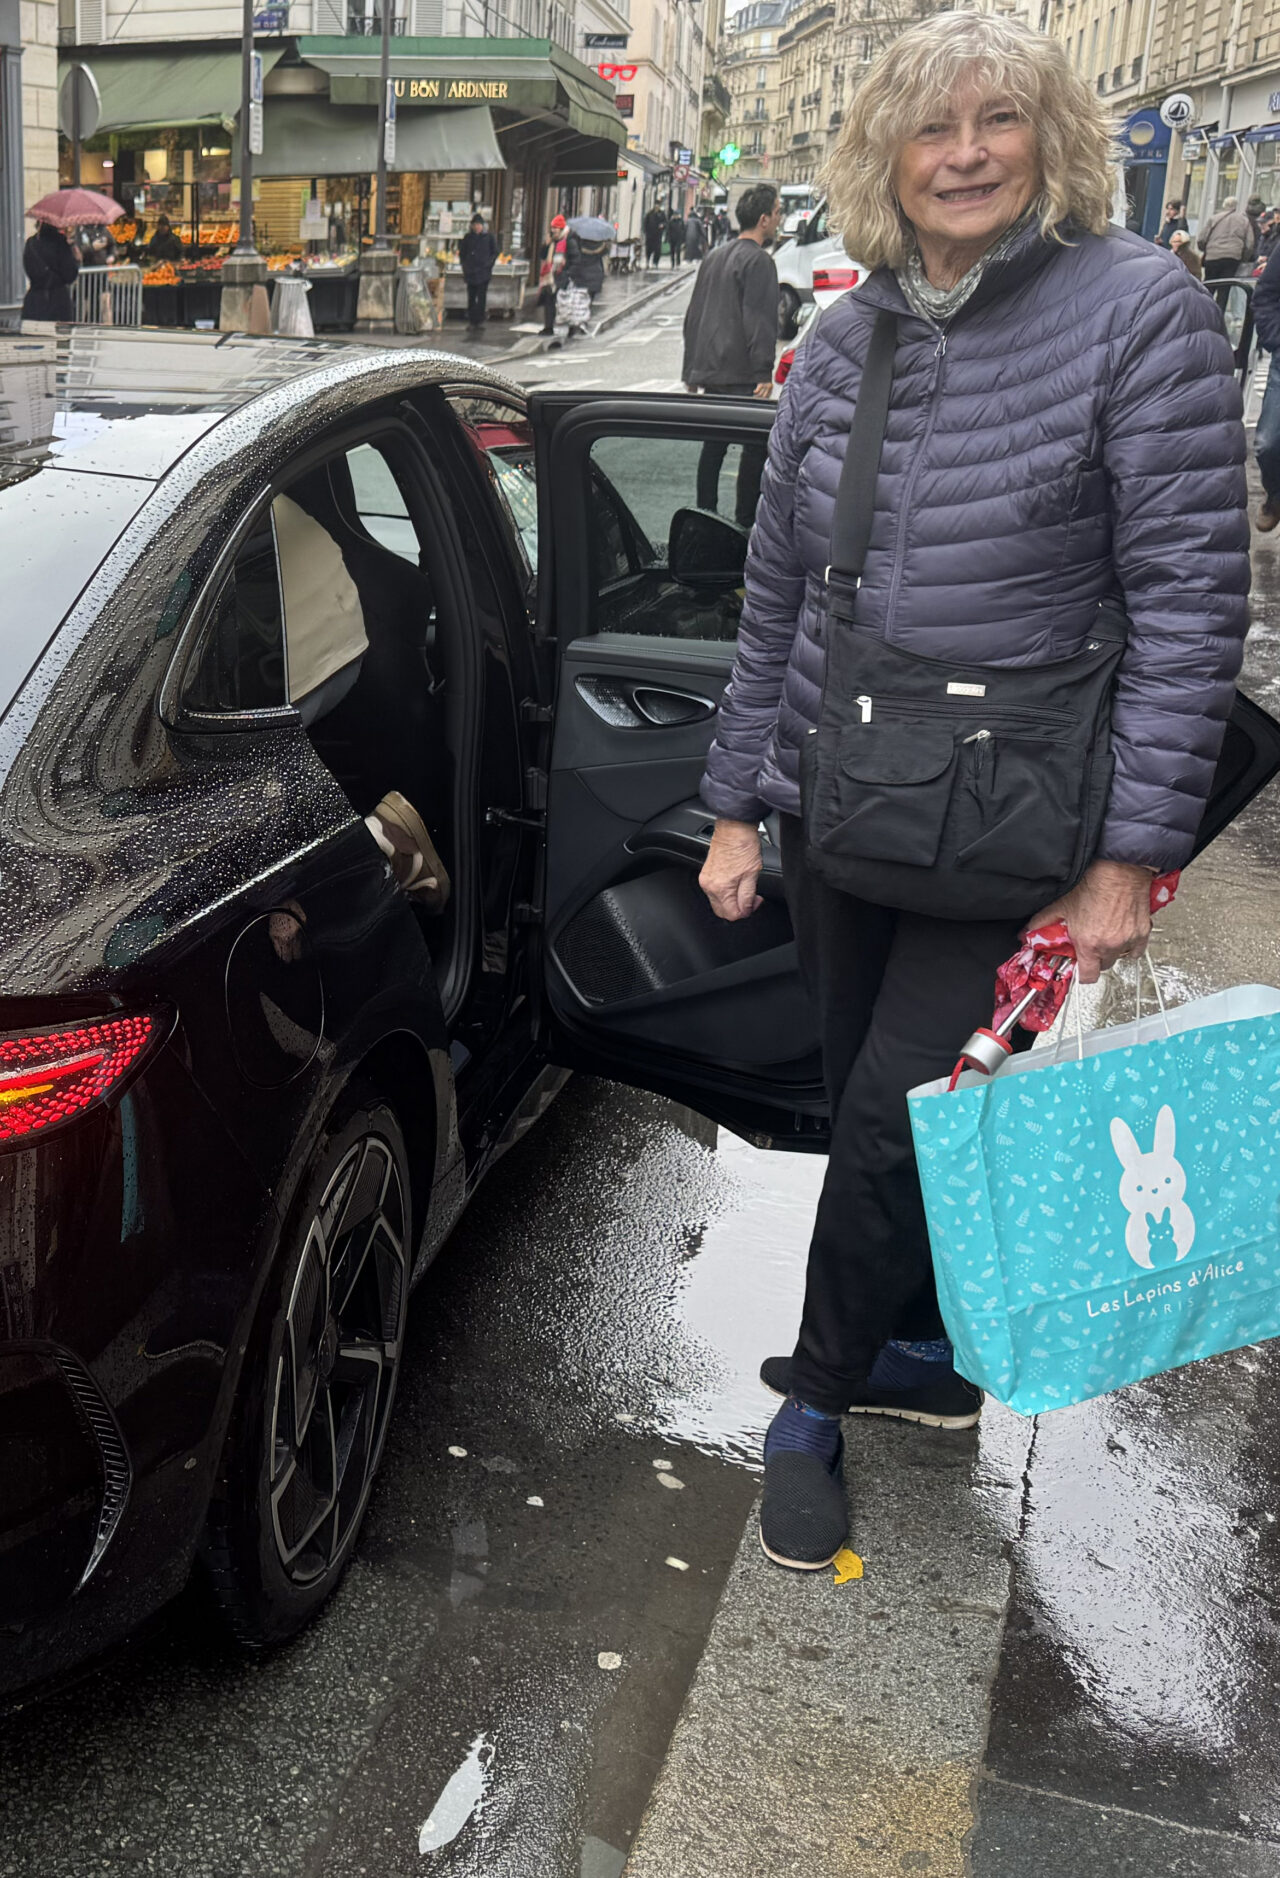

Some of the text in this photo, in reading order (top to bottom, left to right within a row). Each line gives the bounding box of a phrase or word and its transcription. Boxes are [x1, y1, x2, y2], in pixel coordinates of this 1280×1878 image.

[410, 79, 440, 99] BON
[1086, 1260, 1245, 1318] Les Lapins d'Alice
[1137, 1296, 1195, 1322] PARIS
